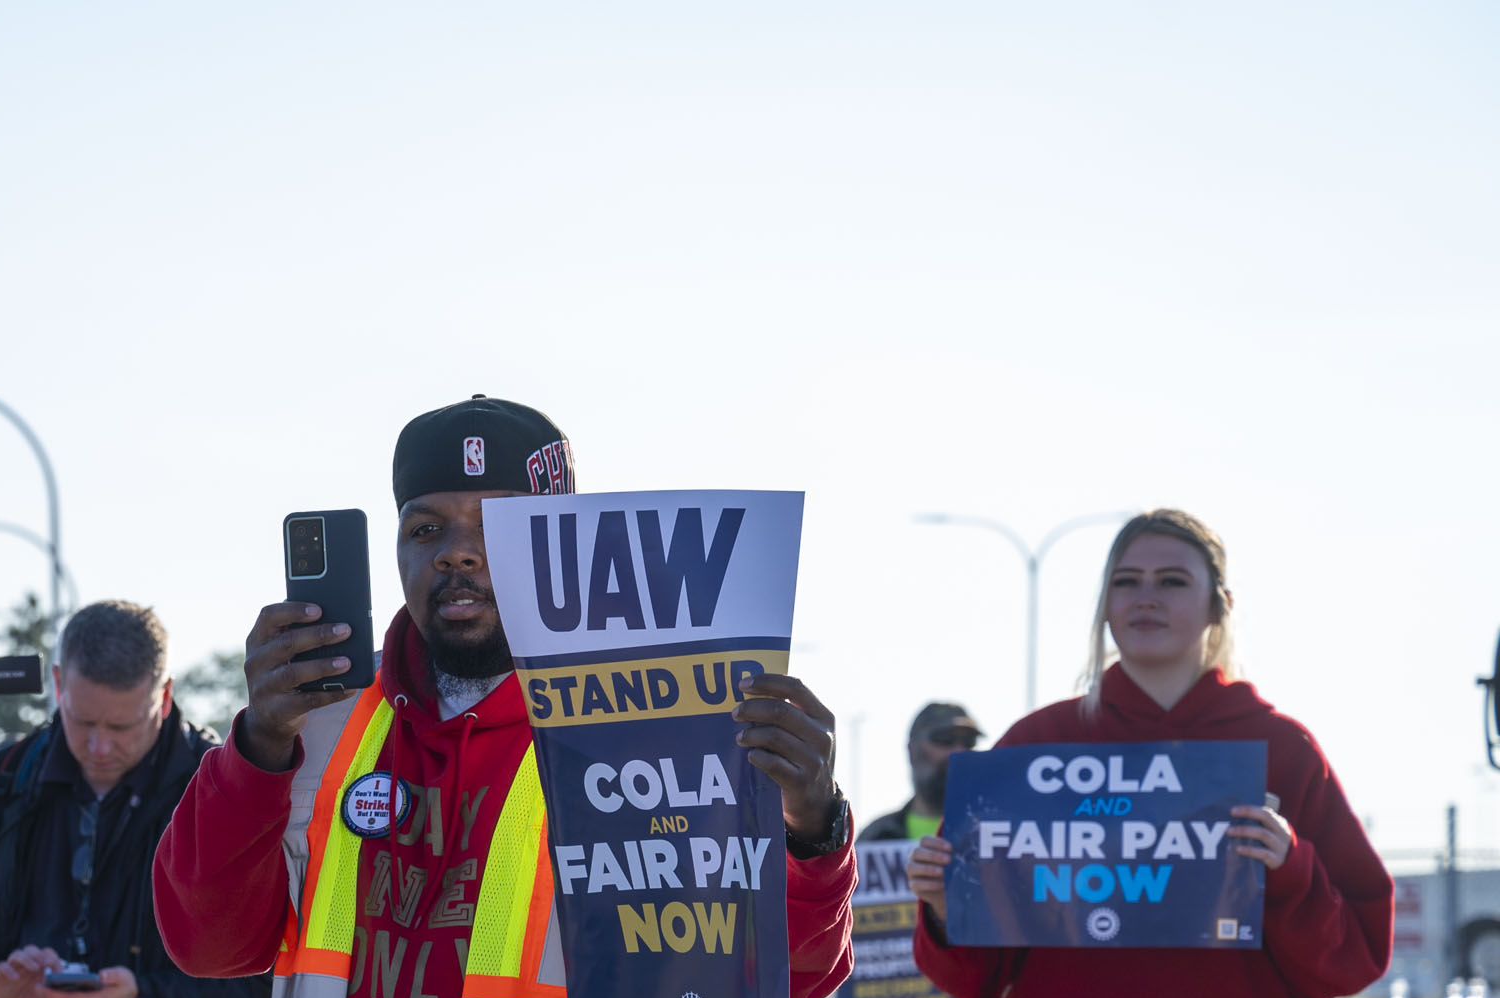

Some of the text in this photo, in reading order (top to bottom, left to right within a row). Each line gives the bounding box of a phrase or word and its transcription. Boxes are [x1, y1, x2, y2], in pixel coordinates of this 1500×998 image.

[530, 507, 746, 632] UAW
[527, 660, 765, 720] STAND UP
[374, 780, 380, 790] I
[584, 754, 737, 813] COLA
[1027, 754, 1183, 794] COLA
[650, 815, 689, 834] AND
[1074, 797, 1133, 816] AND
[978, 821, 1230, 860] FAIR PAY
[554, 837, 772, 895] FAIR PAY
[1033, 864, 1174, 903] NOW
[617, 901, 738, 954] NOW
